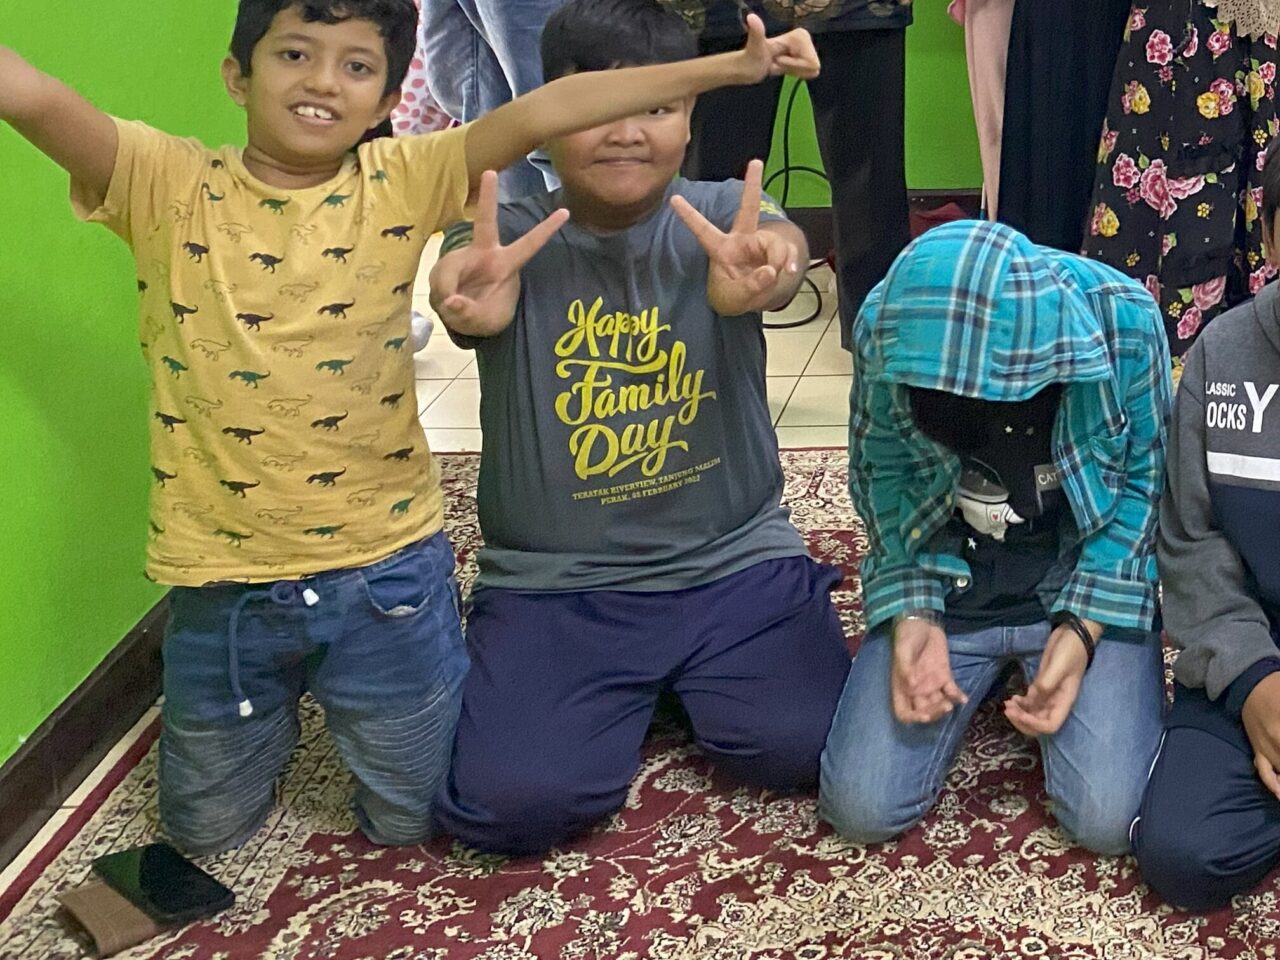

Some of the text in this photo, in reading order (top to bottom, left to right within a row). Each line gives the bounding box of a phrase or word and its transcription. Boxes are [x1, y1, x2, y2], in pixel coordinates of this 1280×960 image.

[554, 296, 672, 362] Happy
[554, 341, 717, 426] Family
[1206, 401, 1247, 431] OCKS
[568, 416, 689, 480] Day
